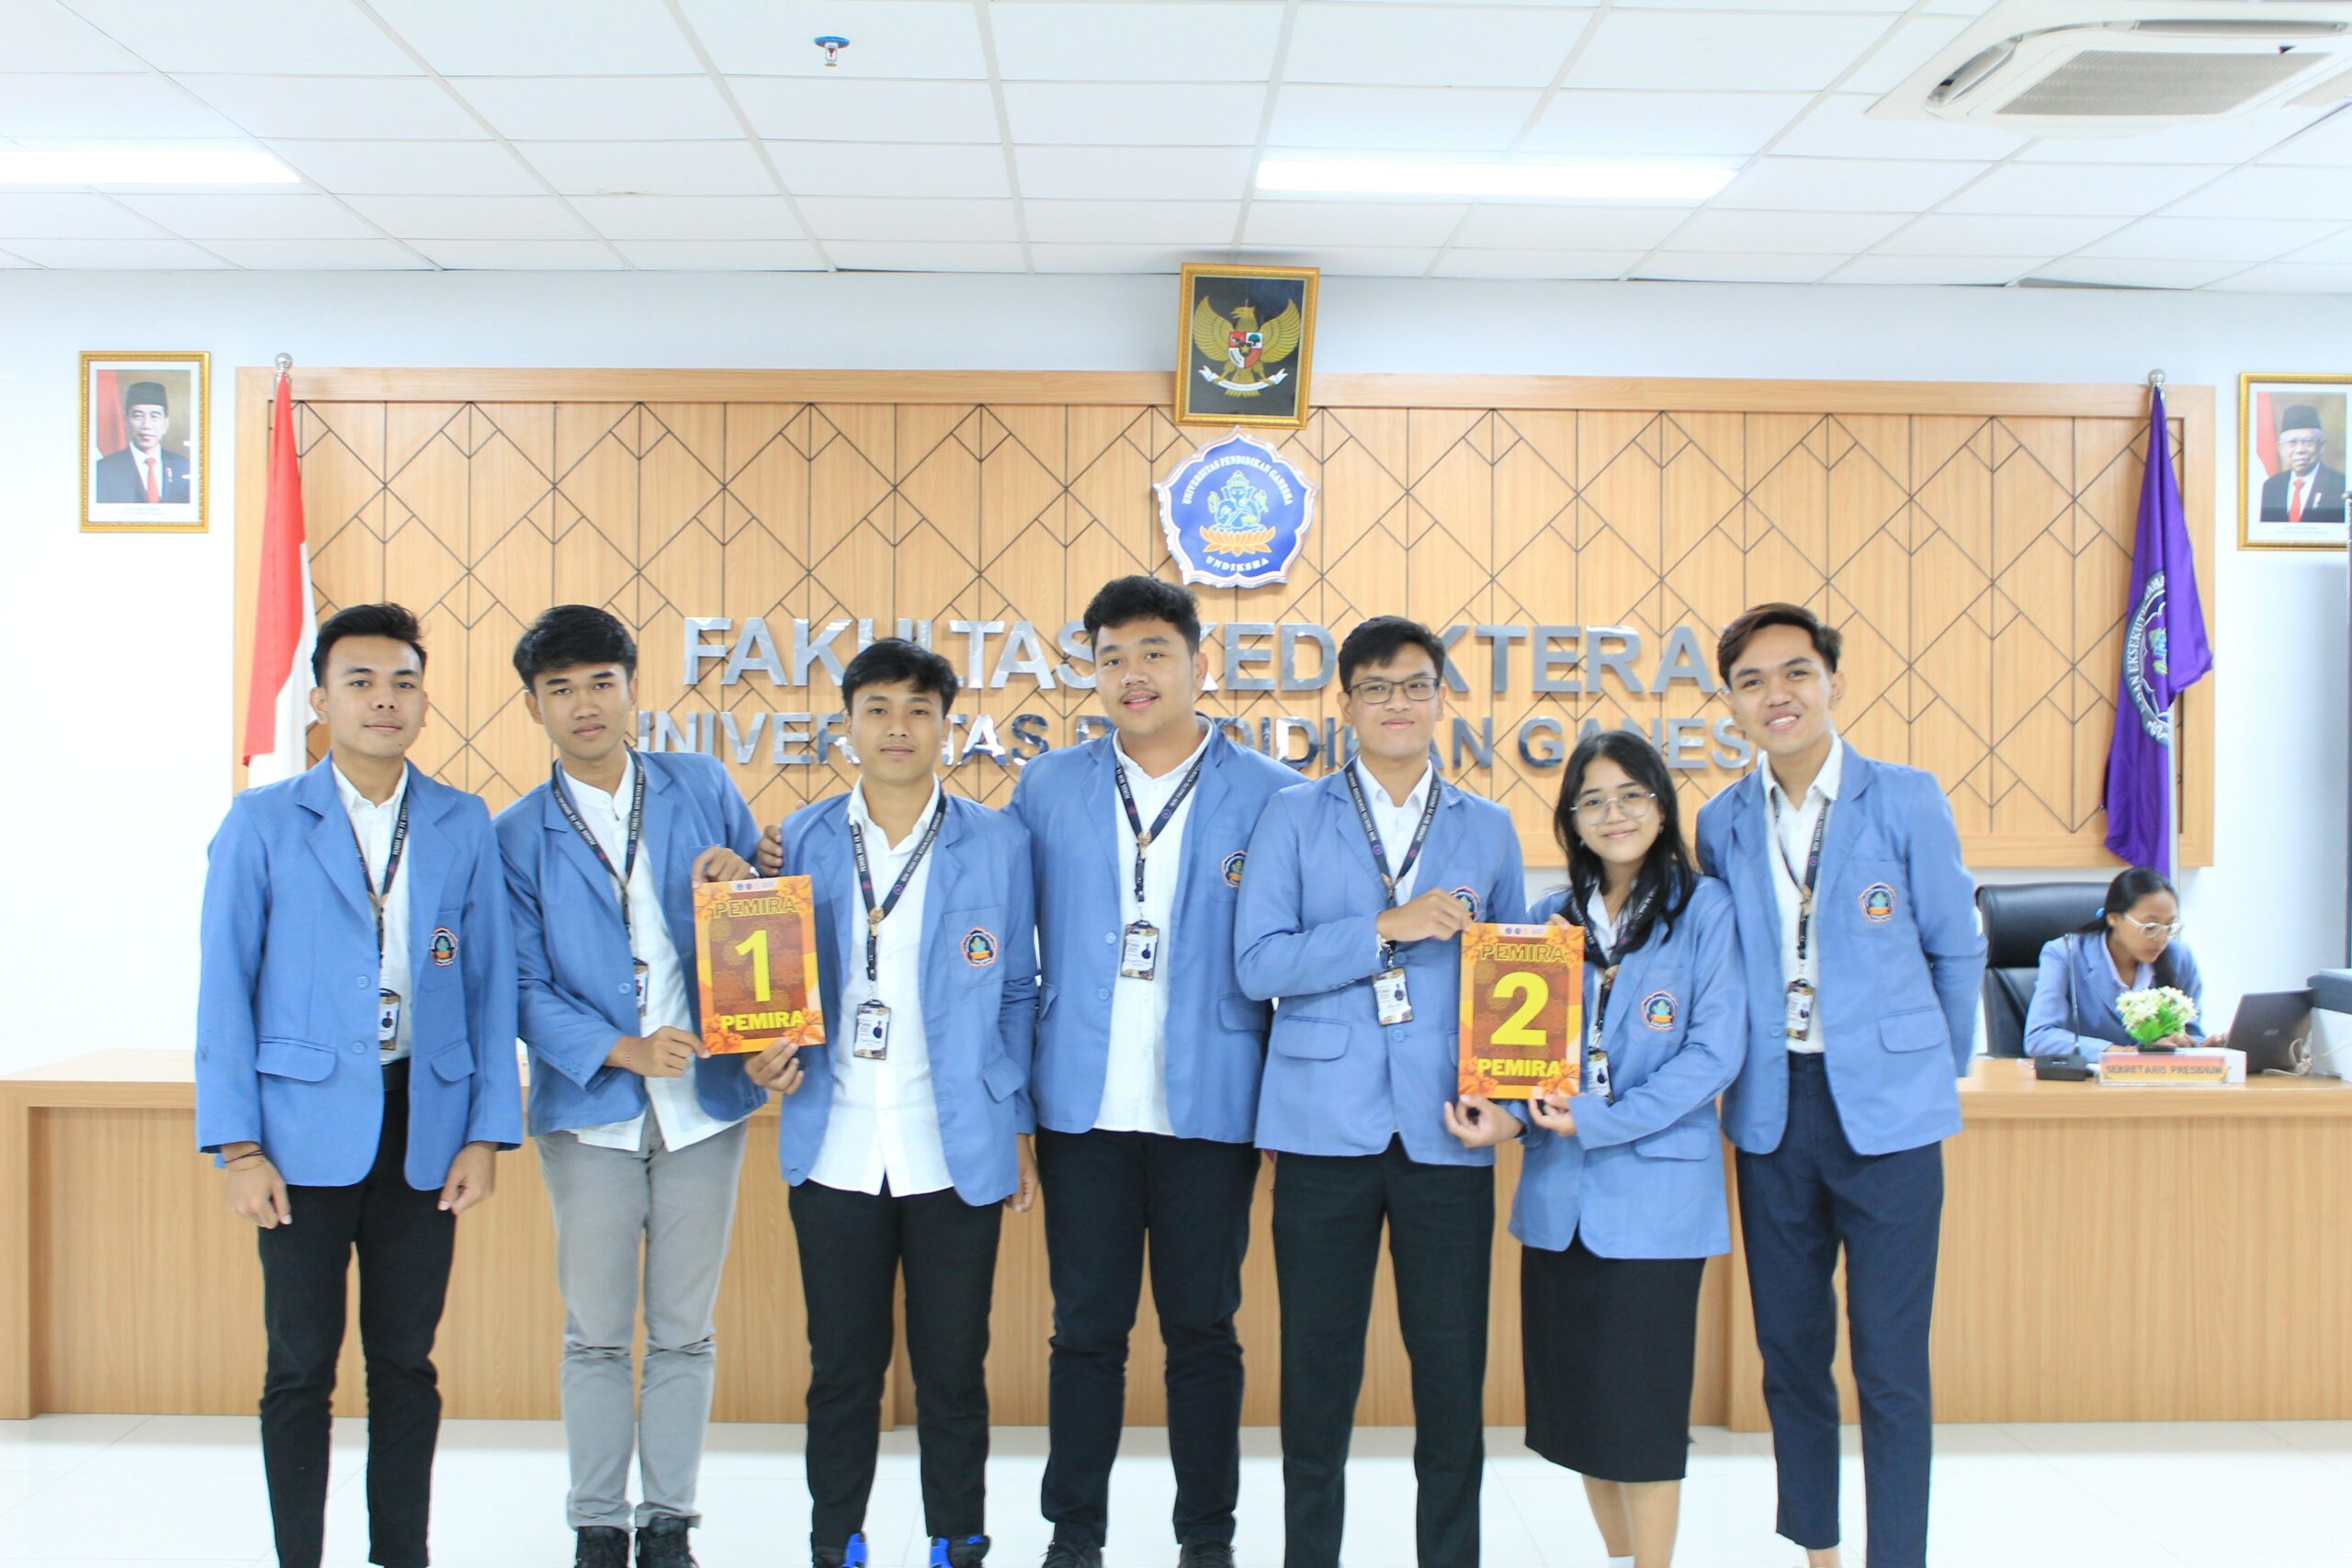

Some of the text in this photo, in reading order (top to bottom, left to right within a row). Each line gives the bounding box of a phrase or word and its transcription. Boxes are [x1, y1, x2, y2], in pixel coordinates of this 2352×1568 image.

[1182, 459, 1221, 504] UNIVERSITAS
[1219, 455, 1272, 474] PENDIDIKAN
[1205, 556, 1270, 571] UNDIKSHA
[713, 897, 798, 919] PEMIRA
[1480, 942, 1567, 964] PEMIRA
[735, 929, 772, 1002] 1
[1490, 971, 1549, 1045] 2
[720, 1010, 806, 1031] PEMIRA
[1476, 1058, 1561, 1077] PEMIRA
